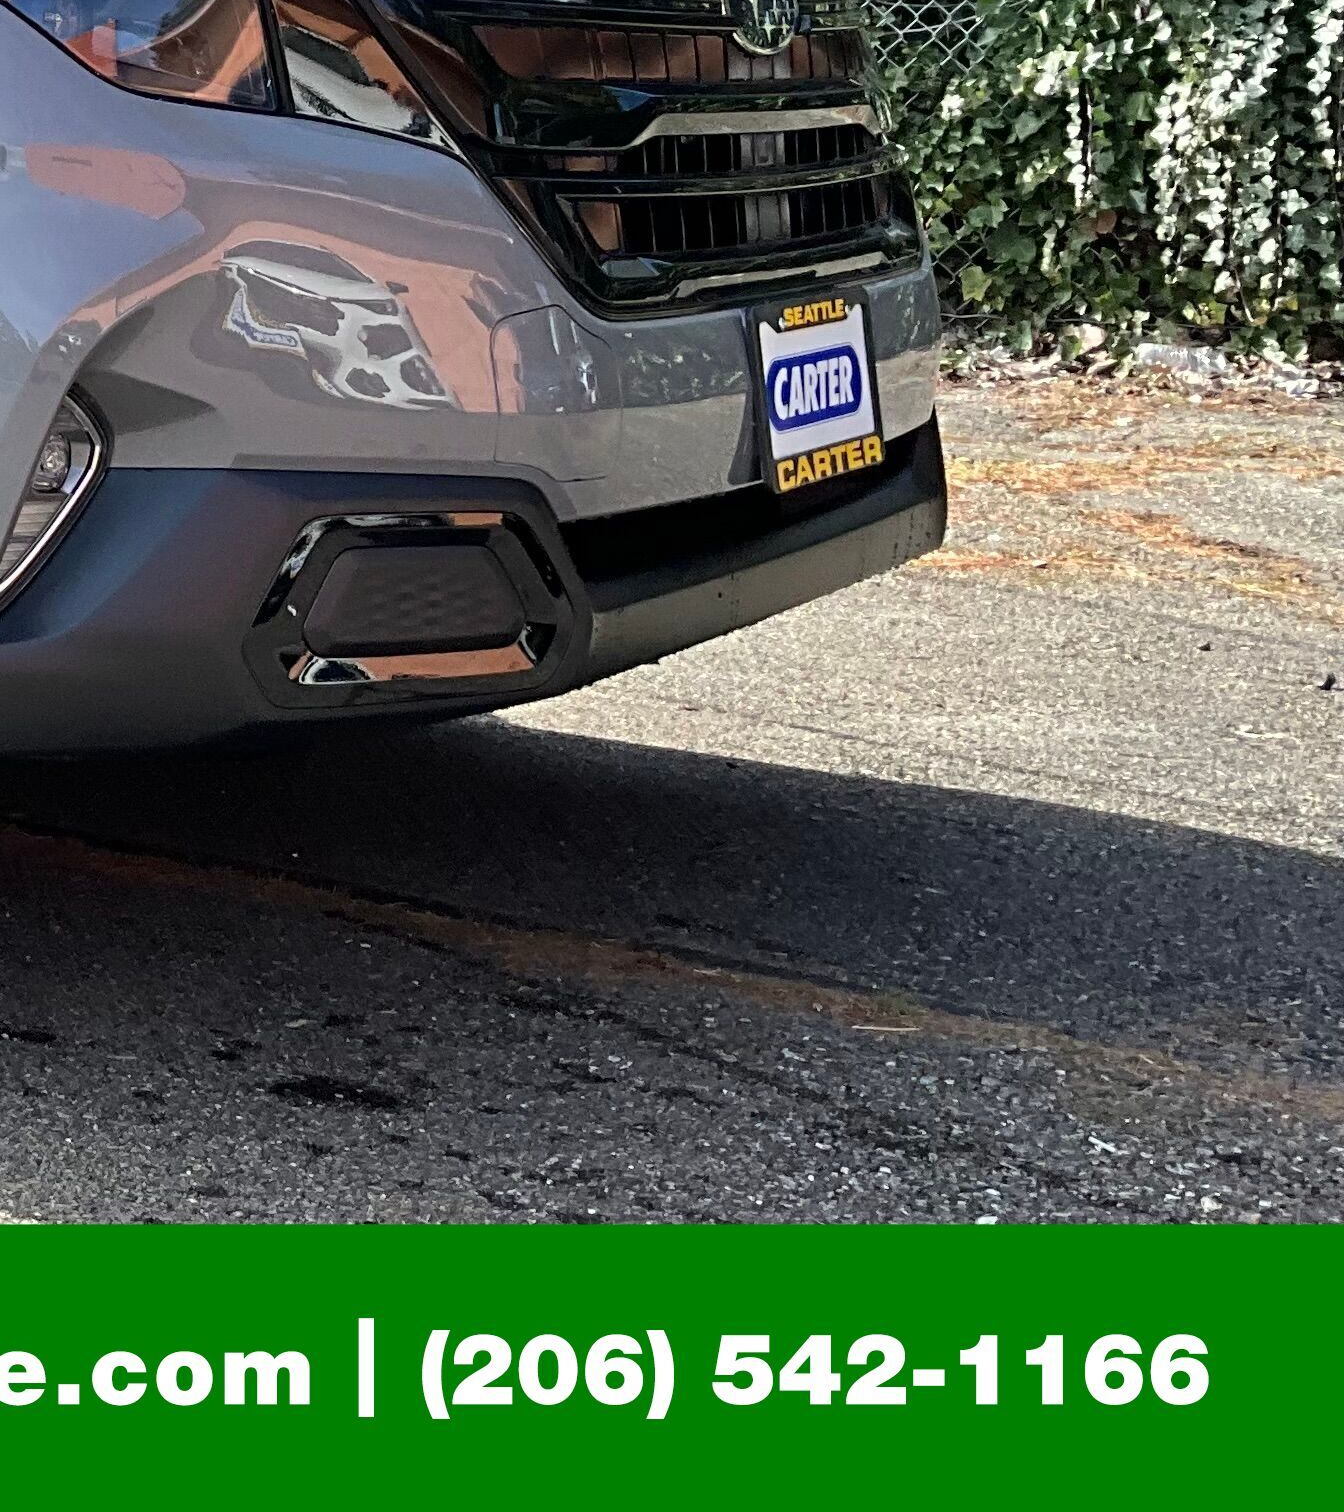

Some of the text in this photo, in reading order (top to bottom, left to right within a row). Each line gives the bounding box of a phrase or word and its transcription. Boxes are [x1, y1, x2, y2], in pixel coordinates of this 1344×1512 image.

[782, 298, 845, 328] SEATTLE
[774, 355, 855, 420] CARTER
[776, 435, 884, 492] CARTER
